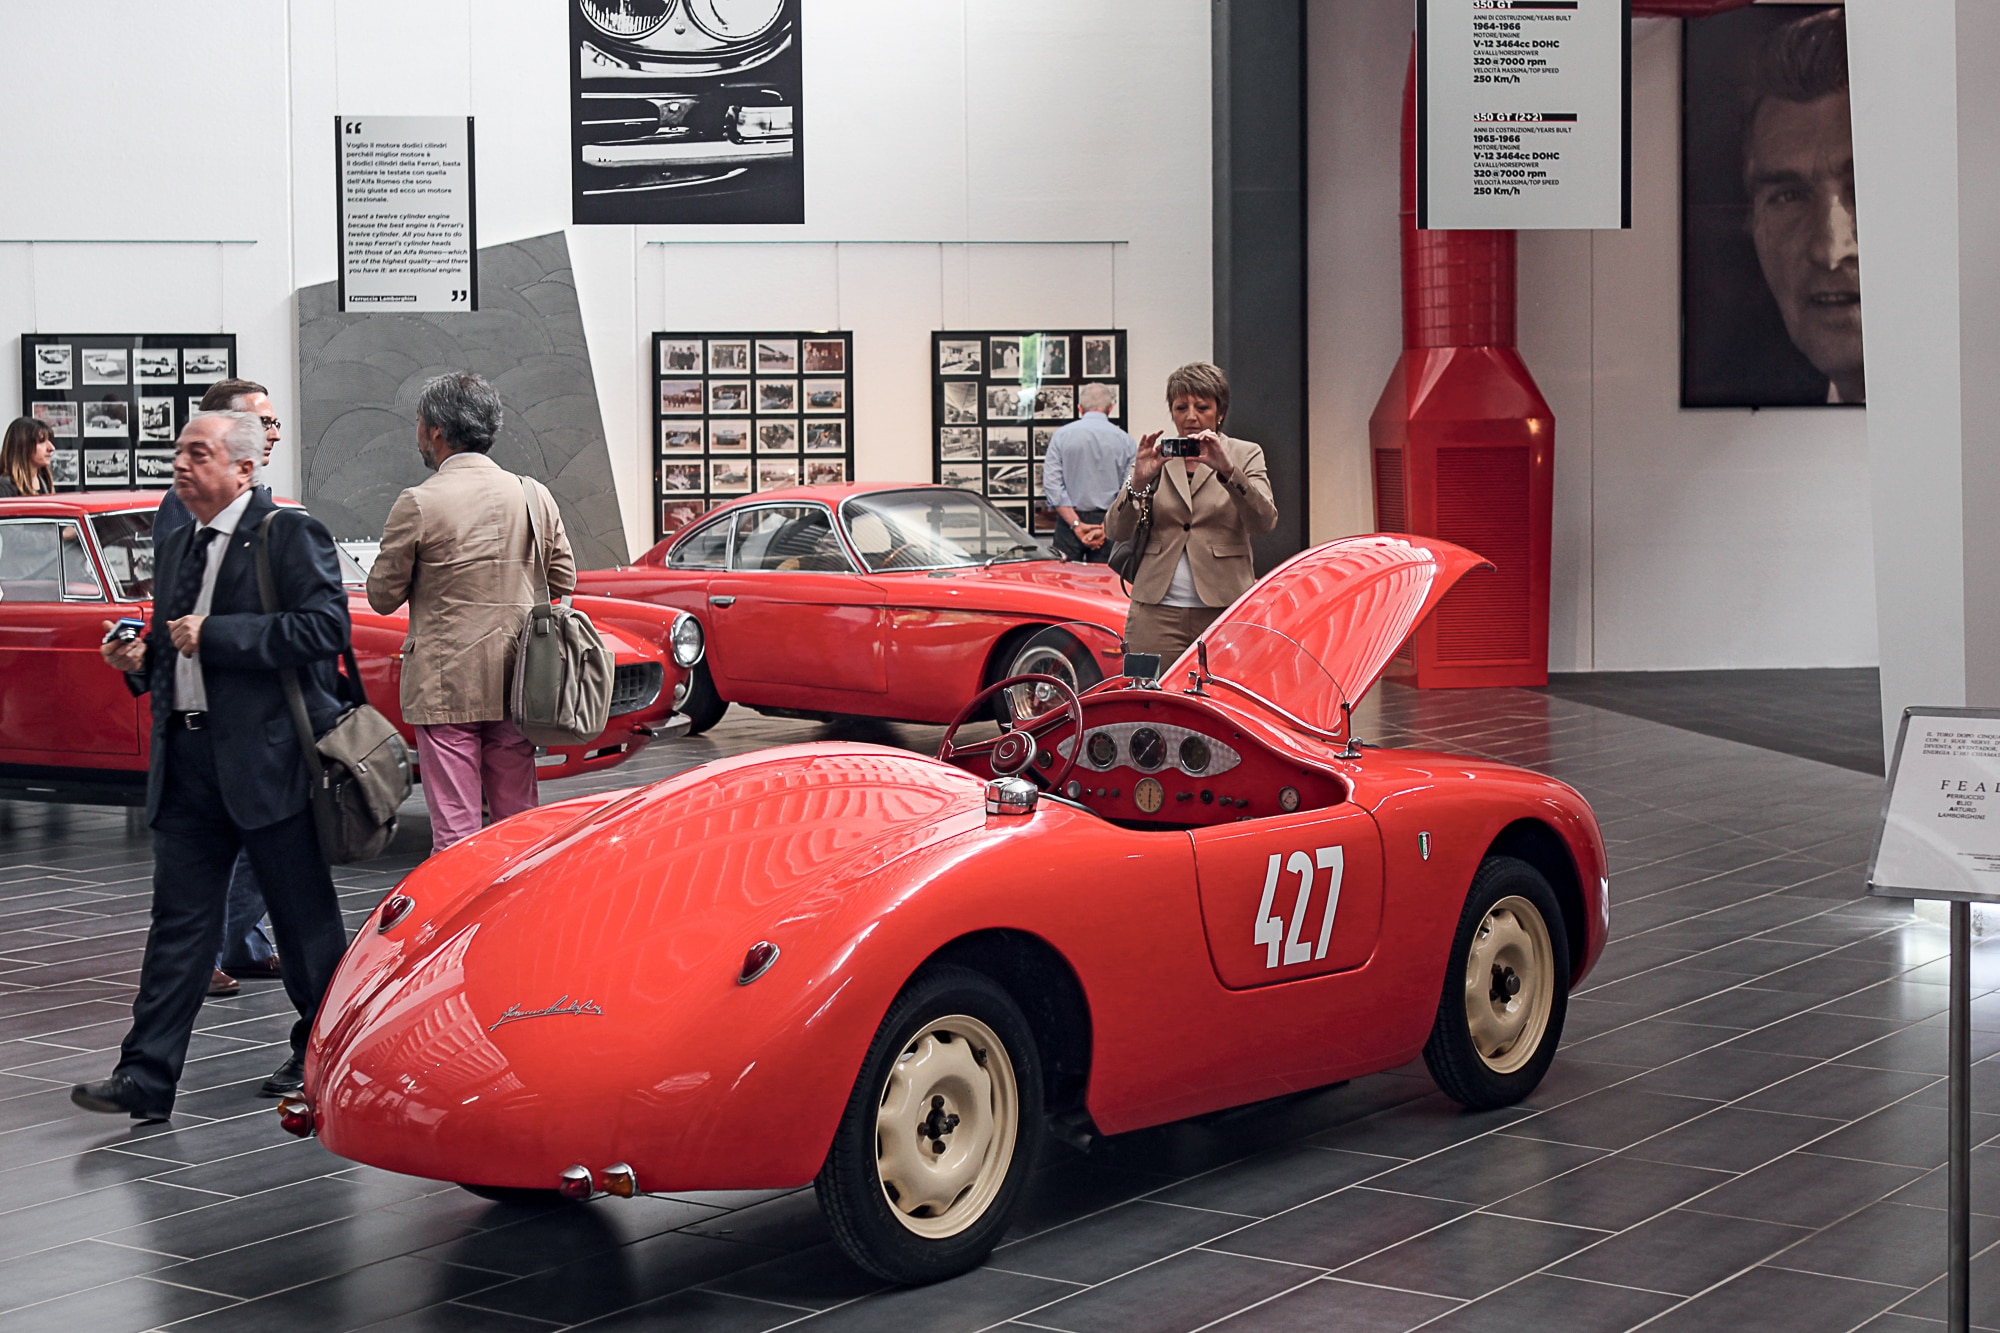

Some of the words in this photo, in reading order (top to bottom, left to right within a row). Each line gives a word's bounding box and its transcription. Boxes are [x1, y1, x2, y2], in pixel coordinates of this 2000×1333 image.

[1474, 0, 1493, 8] 350
[1497, 0, 1513, 8] GT
[1473, 40, 1493, 48] V-12
[1496, 40, 1530, 48] 3464cc
[1532, 40, 1559, 48] DOHC
[1527, 59, 1546, 67] rpm
[1473, 75, 1491, 83] 250
[1494, 75, 1520, 83] Km/h
[1474, 112, 1493, 120] 350
[1497, 112, 1513, 120] GT
[1515, 112, 1543, 120] (2+2)
[1473, 152, 1493, 160] V-12
[1496, 152, 1530, 160] 3464cc
[1532, 152, 1559, 160] DOHC
[1527, 171, 1546, 179] rpm
[1473, 187, 1491, 195] 250
[1494, 187, 1520, 195] Km/h
[1254, 845, 1344, 969] 427
